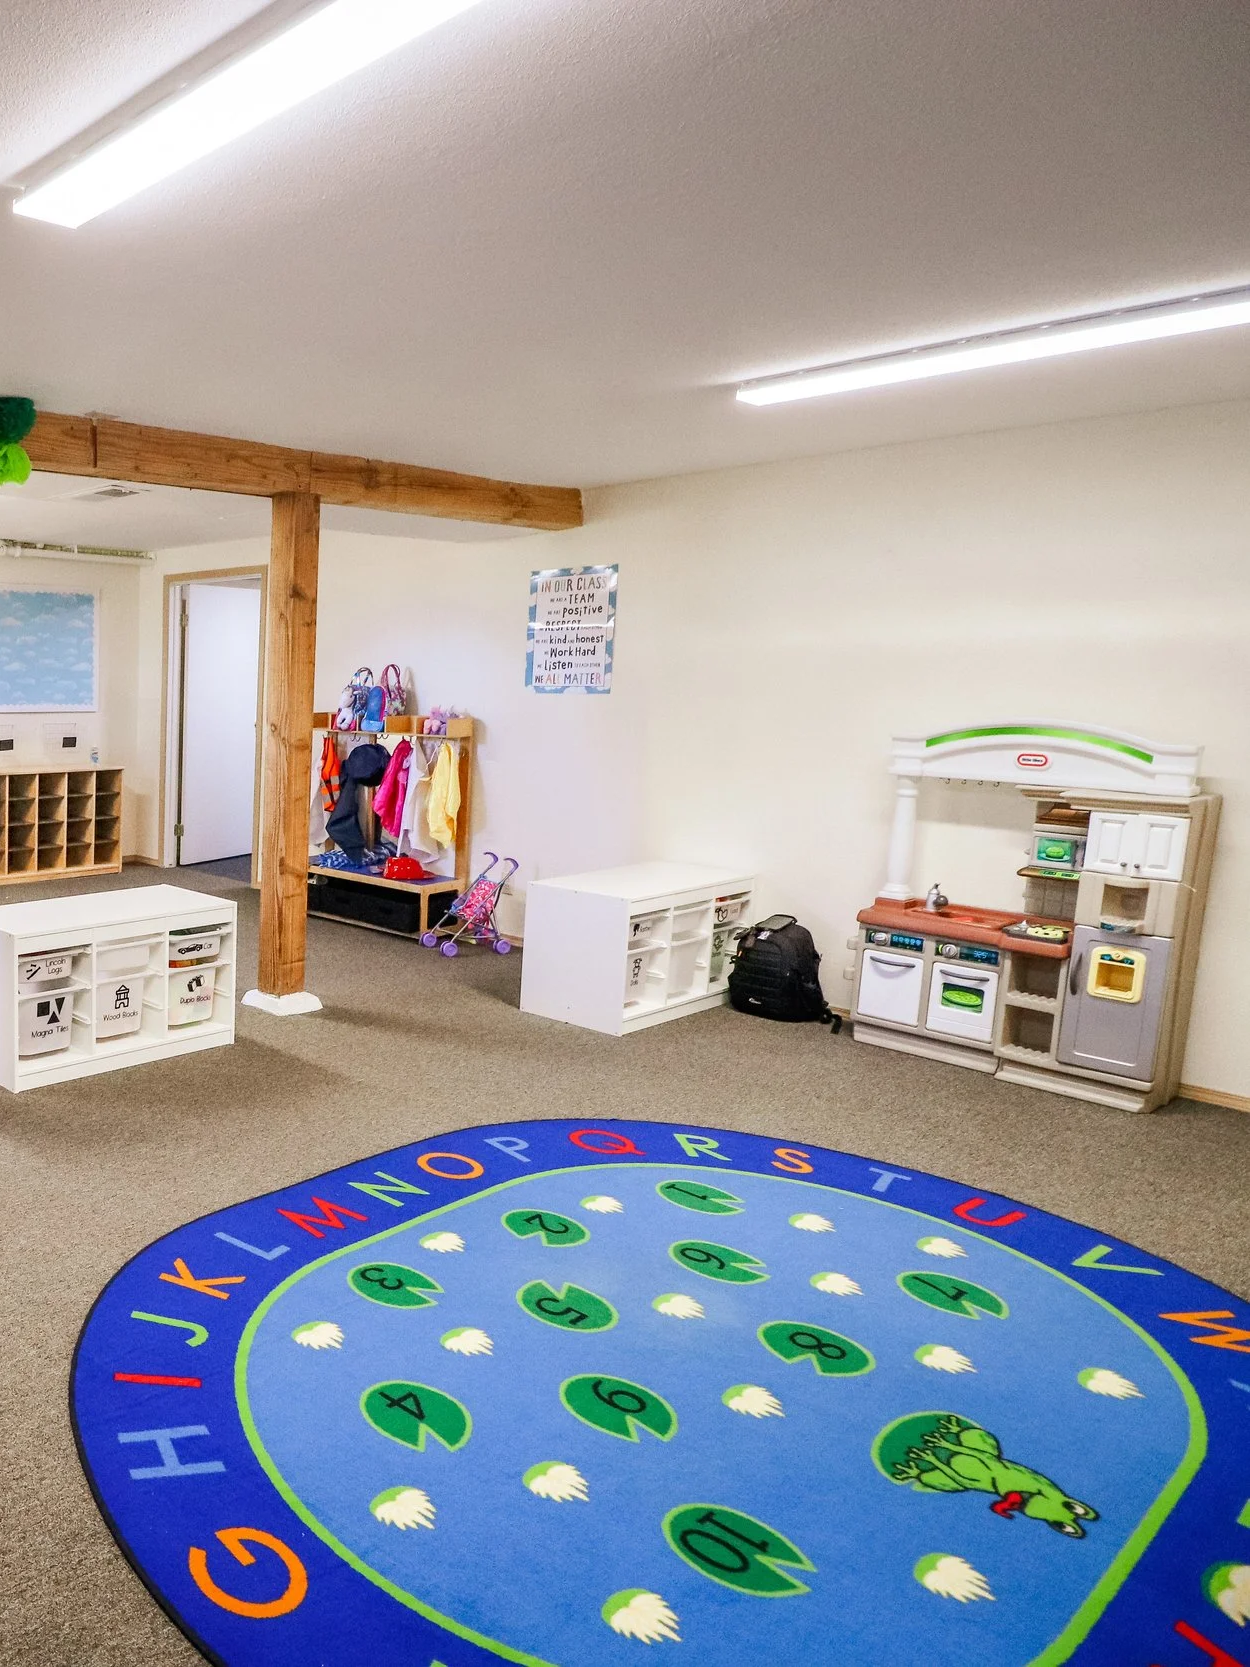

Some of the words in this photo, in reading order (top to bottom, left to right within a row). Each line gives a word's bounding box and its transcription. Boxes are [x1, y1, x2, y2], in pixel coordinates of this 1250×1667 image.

[541, 579, 552, 593] IN
[554, 578, 573, 593] OUR
[576, 576, 608, 592] CLASS
[562, 605, 604, 619] positive
[569, 593, 596, 605] TEAM
[549, 634, 567, 645] kind
[575, 633, 605, 644] honest
[550, 646, 575, 659] Work
[575, 645, 597, 657] Hard
[534, 674, 544, 684] WE
[563, 672, 602, 685] MATTER
[544, 659, 574, 672] Listen
[45, 957, 66, 968] Lincoln
[47, 966, 63, 976] Logs
[102, 1012, 121, 1021] Wood
[31, 1028, 54, 1039] Magna
[55, 1024, 70, 1033] Tiles
[483, 1135, 532, 1163] P
[568, 1129, 647, 1157] Q
[673, 1132, 732, 1162] R
[417, 1152, 485, 1180] O
[771, 1147, 814, 1175] S
[347, 1171, 431, 1208] N
[868, 1167, 912, 1193] T
[276, 1196, 369, 1239] M
[522, 1213, 569, 1235] 2
[952, 1197, 1027, 1228] U
[214, 1231, 291, 1261] L
[1071, 1244, 1165, 1277] V
[158, 1257, 246, 1300] K
[360, 1266, 405, 1291] 3
[535, 1297, 589, 1326] 5
[130, 1310, 209, 1347] J
[788, 1330, 847, 1361] 8
[113, 1372, 201, 1388] I
[377, 1391, 427, 1422] 4
[117, 1424, 226, 1480] H
[679, 1511, 770, 1574] 10
[189, 1527, 308, 1619] G
